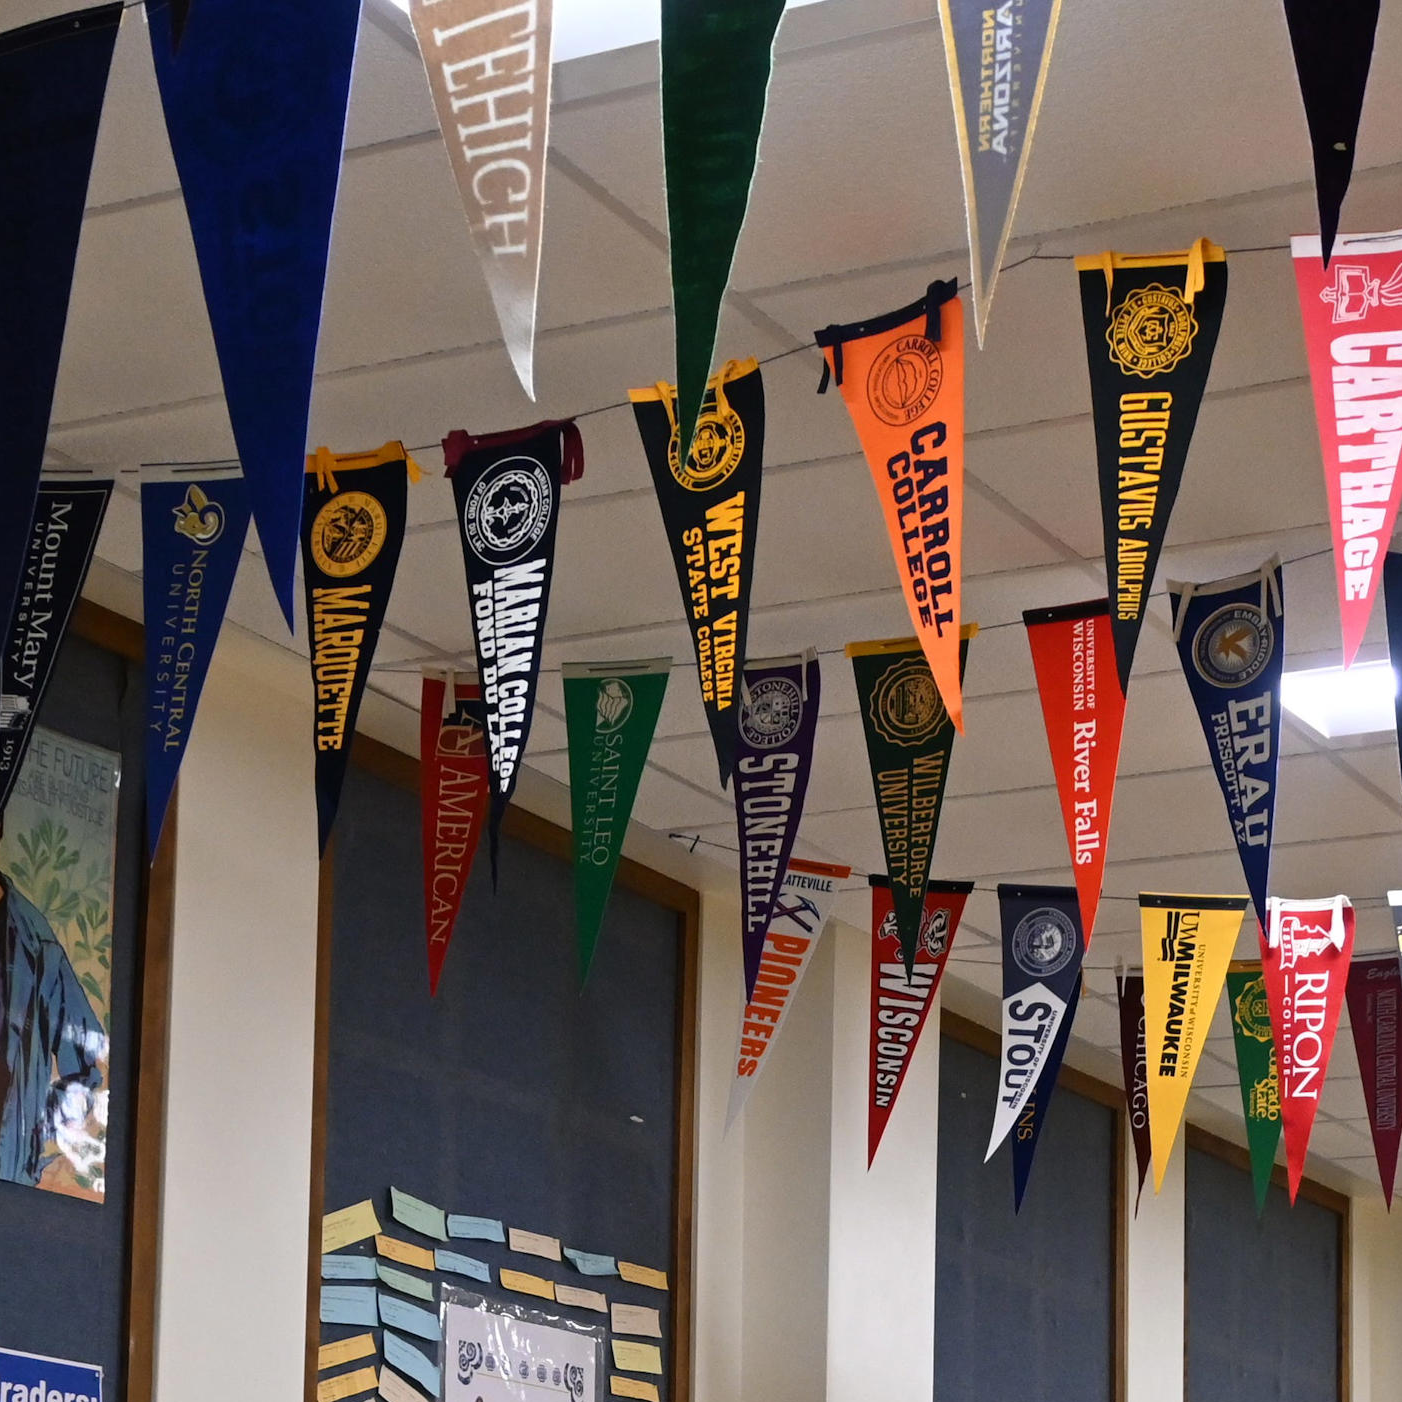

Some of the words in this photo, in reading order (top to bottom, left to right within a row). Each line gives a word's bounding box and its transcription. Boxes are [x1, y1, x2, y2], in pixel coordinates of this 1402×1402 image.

[1116, 390, 1173, 532] GUSTAVUS
[36, 501, 73, 606] Mount
[683, 527, 709, 620] STATE
[703, 489, 746, 600] WEST
[887, 454, 933, 629] COLLEGE
[910, 421, 957, 637] CARROLL
[1116, 536, 1145, 622] ADOLPHUS
[9, 522, 45, 664] UNIVERSITY
[180, 549, 208, 638] NORTH
[473, 579, 497, 656] FOND
[494, 558, 547, 678] MARIAN
[13, 609, 53, 690] Mary
[149, 563, 183, 734] UNIVERSITY
[164, 638, 198, 753] CENTRAL
[312, 584, 372, 753] MARQUETTE
[481, 664, 500, 705] DU
[695, 624, 712, 704] COLLEGE
[713, 608, 739, 712] VIRGINIA
[1073, 621, 1085, 711] WISCONSIN
[1086, 619, 1096, 692] UNIVERSITY
[1085, 695, 1096, 709] OF
[578, 736, 604, 863] UNIVERSITY
[598, 733, 623, 821] SAINT
[1073, 718, 1097, 793] River
[1228, 691, 1273, 848] ERAU
[429, 763, 482, 946] AMERICAN
[590, 823, 616, 867] LEO
[738, 751, 799, 933] STONEHILL
[877, 768, 910, 887] UNIVERSITY
[907, 750, 944, 898] WILBERFORCE
[1074, 800, 1100, 866] Falls
[1234, 819, 1247, 844] AZ
[735, 931, 812, 1079] PIONEERS
[1191, 944, 1206, 1007] UNIVERSITY
[875, 962, 939, 1108] WISCONSIN
[1001, 999, 1053, 1110] STOUT
[1180, 1017, 1197, 1079] WISCONSIN
[1282, 996, 1292, 1076] COLLEGE
[1292, 970, 1330, 1100] RIPON
[1254, 1078, 1268, 1119] State
